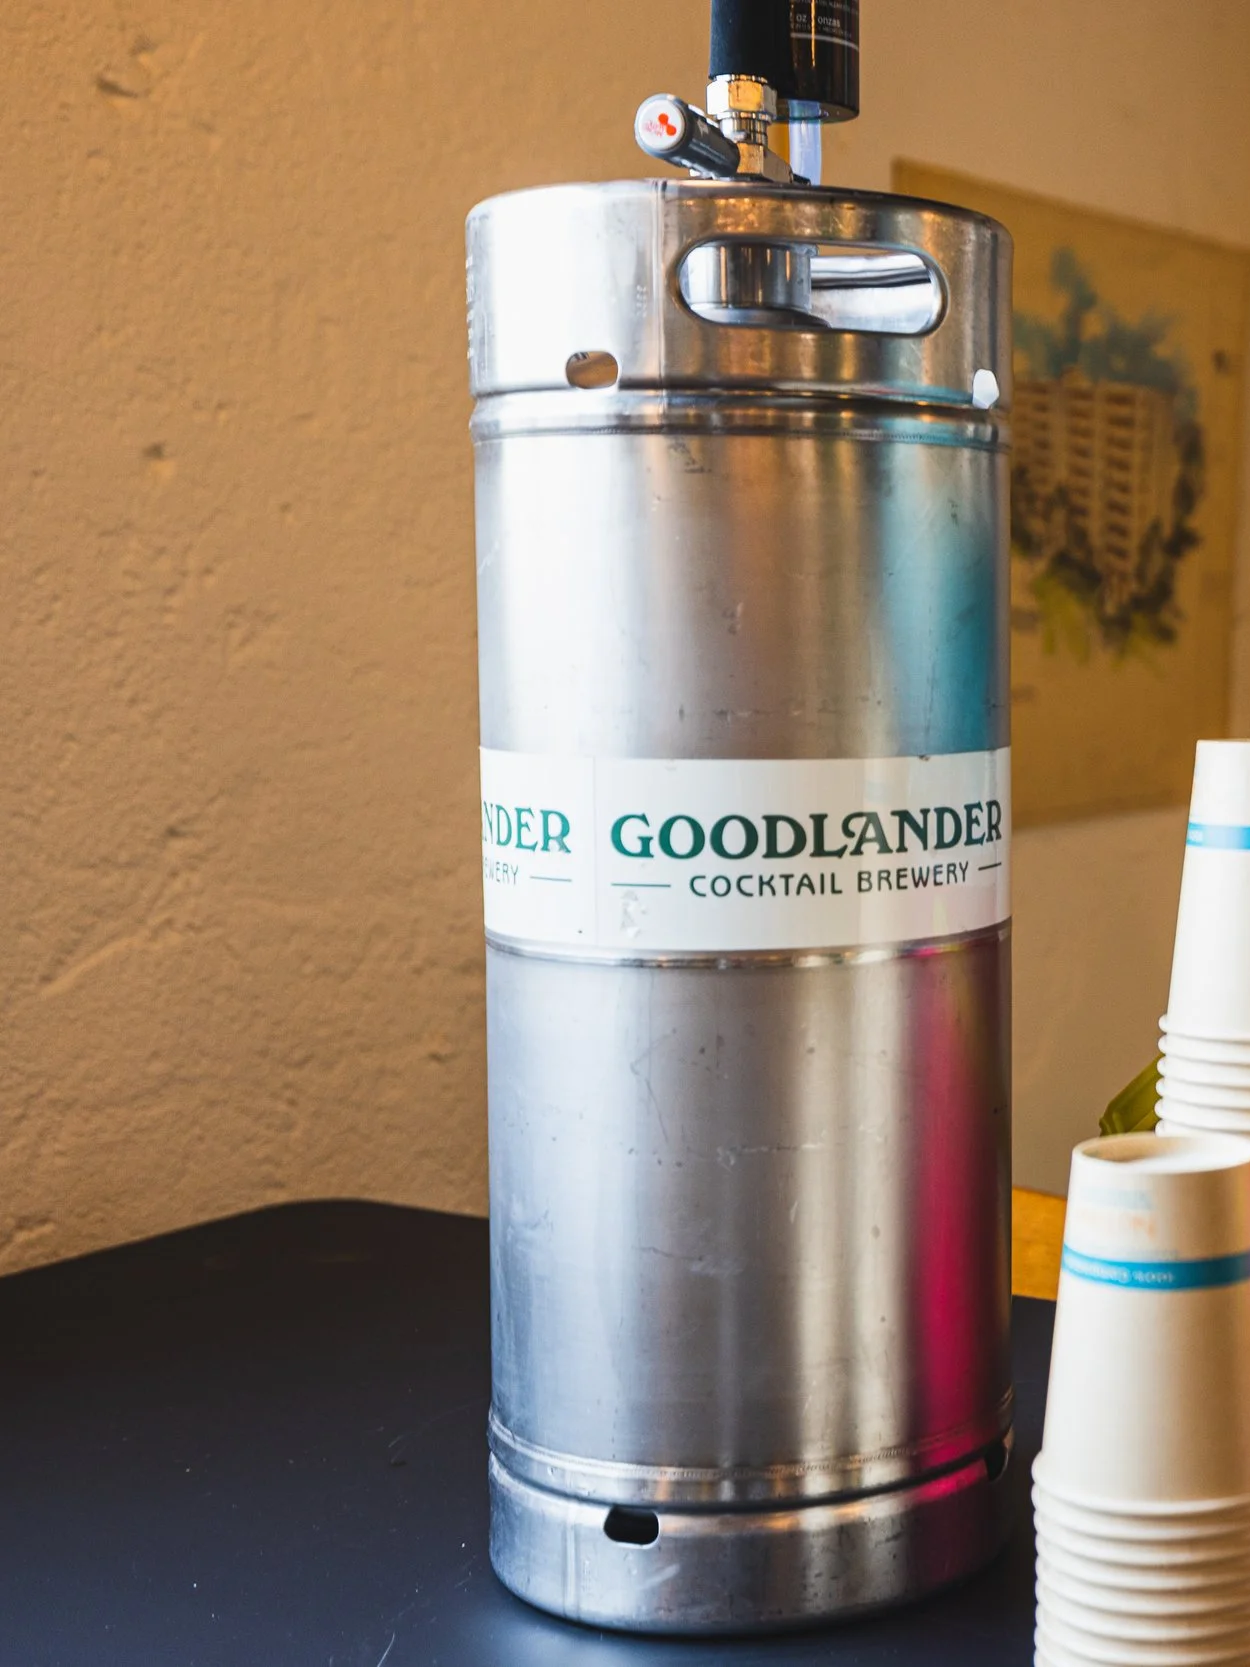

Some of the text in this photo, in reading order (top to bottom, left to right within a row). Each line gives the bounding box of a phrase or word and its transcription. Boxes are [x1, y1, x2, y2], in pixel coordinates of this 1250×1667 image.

[610, 799, 1003, 860] GOODLANDER
[689, 860, 970, 899] COCKTAIL BREWERY
